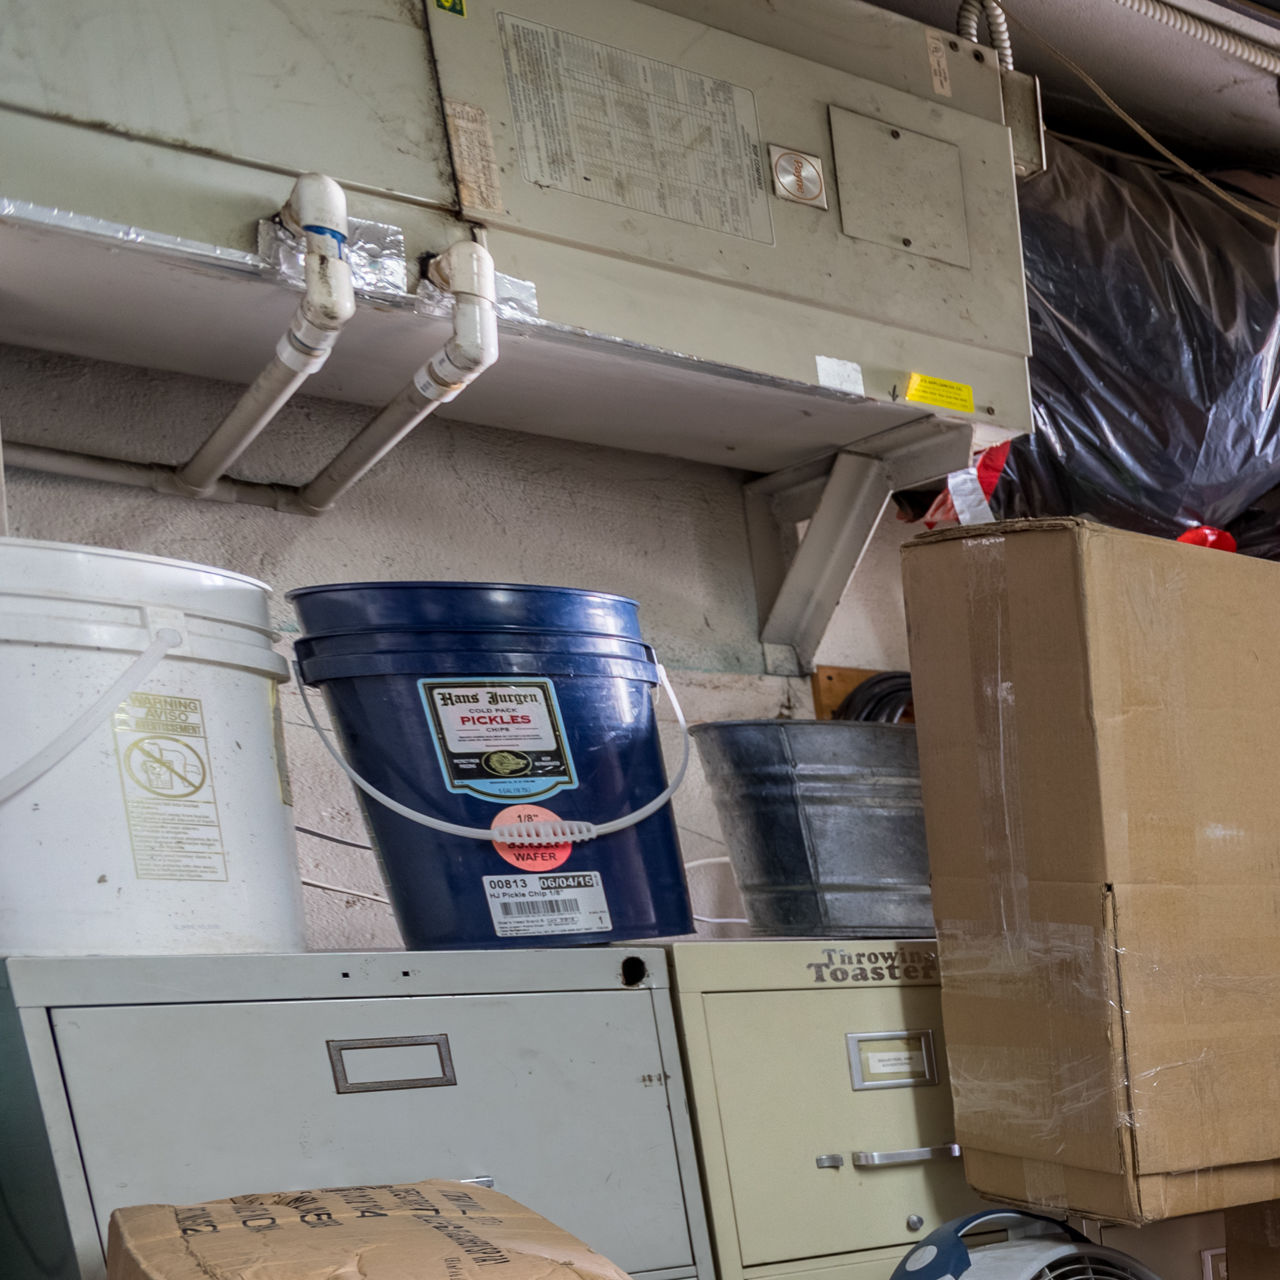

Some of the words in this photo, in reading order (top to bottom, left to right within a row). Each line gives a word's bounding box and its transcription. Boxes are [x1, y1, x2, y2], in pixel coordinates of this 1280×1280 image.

[793, 159, 805, 194] Payne
[132, 694, 198, 712] WARNING
[437, 692, 479, 707] Hans
[486, 691, 538, 706] Jurgen
[145, 708, 189, 722] AVISO
[460, 715, 531, 725] PICKLES
[514, 852, 557, 862] WAFER
[489, 878, 528, 890] 00813
[539, 876, 593, 889] 06/04/15
[529, 890, 547, 898] Chip
